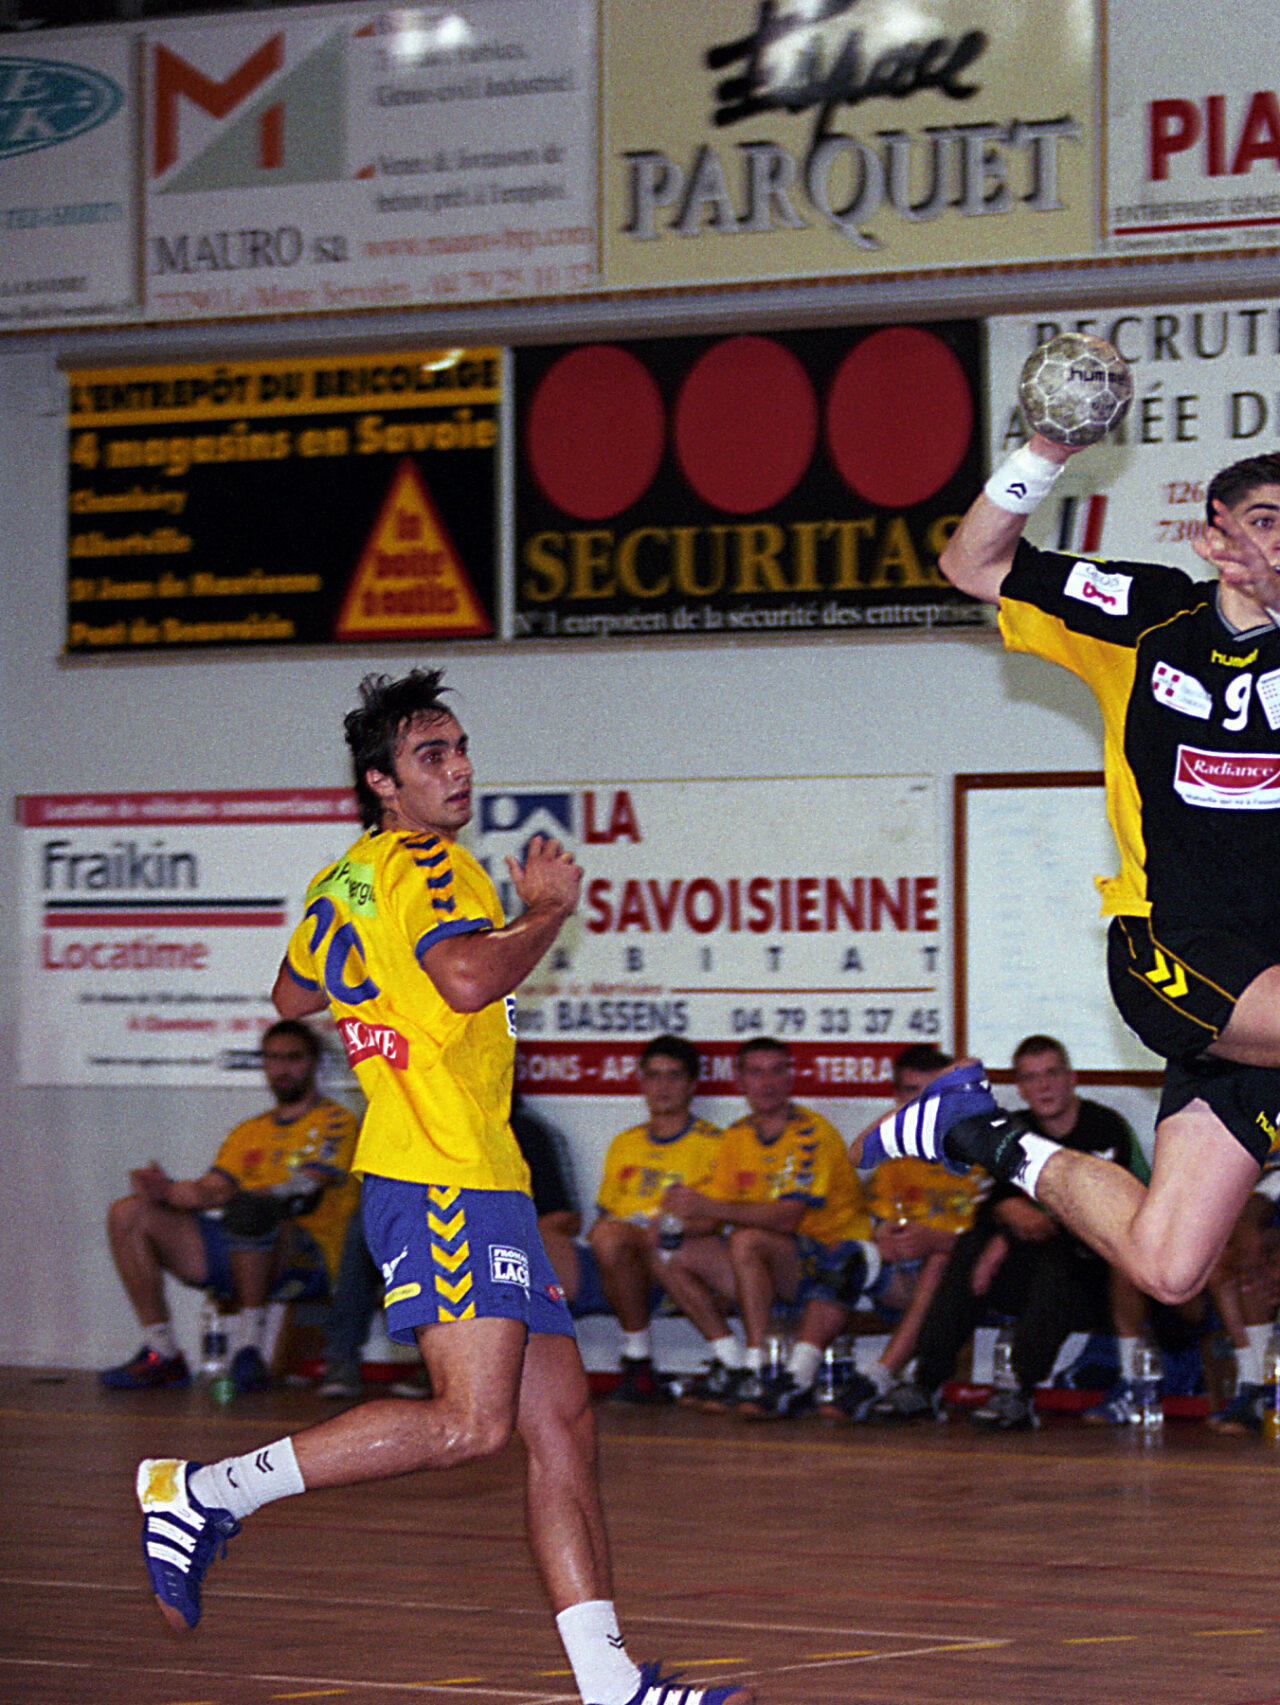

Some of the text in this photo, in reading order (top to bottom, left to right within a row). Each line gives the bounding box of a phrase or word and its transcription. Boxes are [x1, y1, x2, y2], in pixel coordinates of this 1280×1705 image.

[620, 113, 1081, 250] PARQUET
[1114, 199, 1221, 224] ENTREPRISE
[152, 227, 304, 276] MAURO
[260, 372, 303, 401] DU
[73, 408, 498, 477] 4 magasins en Savoie
[673, 604, 700, 630] de
[704, 603, 723, 629] la
[727, 599, 817, 628] sécurité
[823, 602, 861, 625] des
[1222, 673, 1253, 731] 9
[1194, 759, 1274, 777] Radiance
[583, 790, 642, 844] LA
[43, 839, 199, 890] Fraikin
[586, 876, 940, 934] SAVOISIENNE
[41, 932, 209, 970] Locatime
[551, 946, 940, 973] ABITAT
[557, 1001, 689, 1033] BASSENS
[733, 1007, 763, 1034] 04
[776, 1007, 806, 1034] 79
[819, 1007, 849, 1034] 33
[864, 1007, 894, 1034] 37
[908, 1007, 940, 1035] 45
[516, 1055, 581, 1082] SONS
[815, 1056, 895, 1083] TERRA
